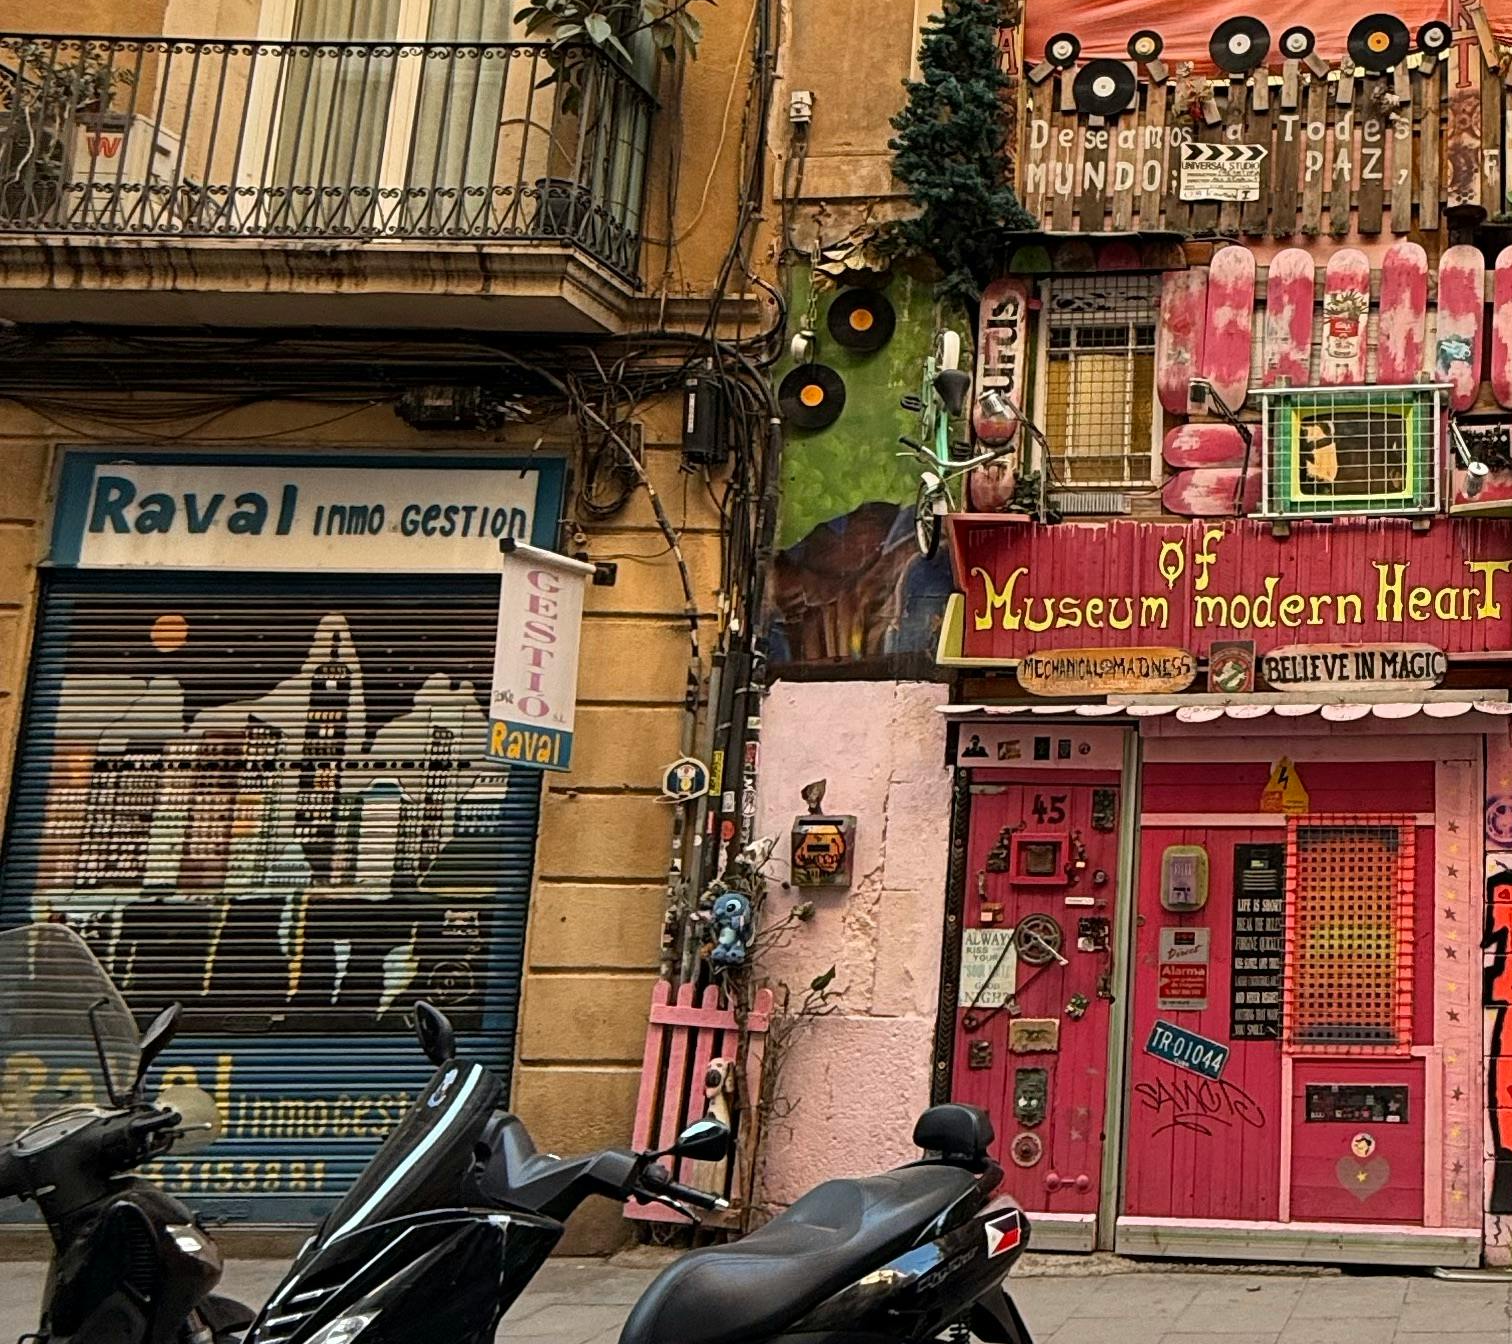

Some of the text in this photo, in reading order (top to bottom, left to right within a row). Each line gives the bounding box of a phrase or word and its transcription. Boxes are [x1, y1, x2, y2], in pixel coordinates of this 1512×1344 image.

[88, 475, 299, 537] Raval
[971, 567, 1168, 630] Museum
[1195, 577, 1363, 629] modern
[1266, 649, 1448, 684] BELIEVE IN MAGIC
[490, 721, 561, 765] Raval
[1032, 794, 1067, 824] 45
[1162, 965, 1205, 976] Alarma
